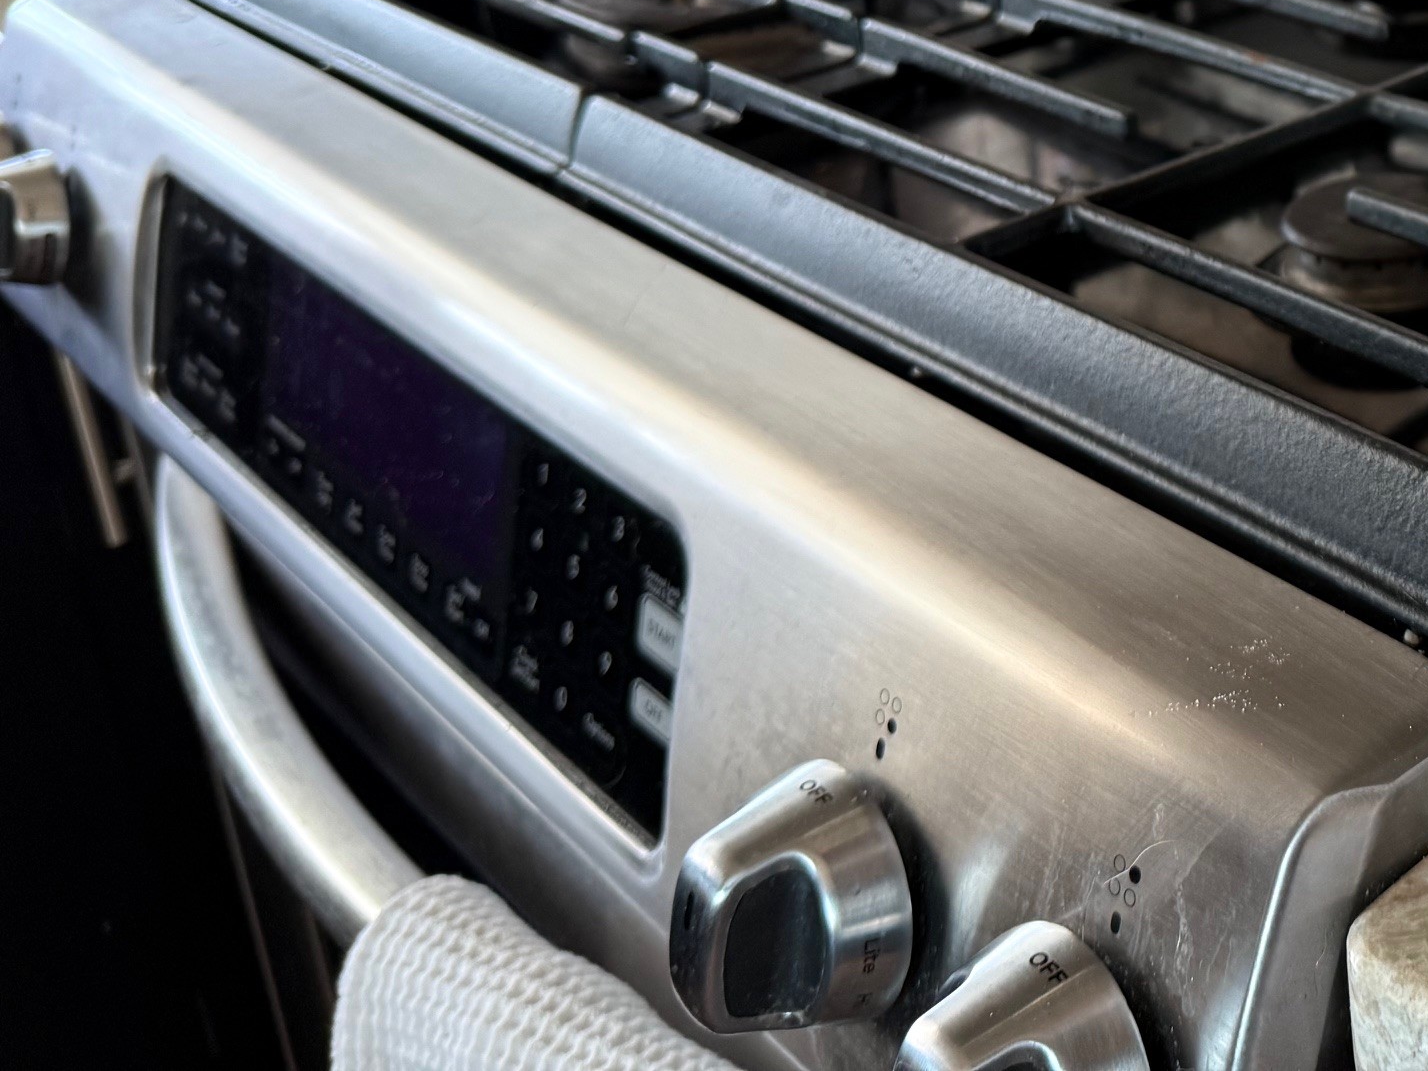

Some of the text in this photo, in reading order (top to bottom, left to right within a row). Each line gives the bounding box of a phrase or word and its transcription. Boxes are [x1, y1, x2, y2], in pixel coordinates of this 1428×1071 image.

[799, 779, 834, 805] OFF
[863, 938, 881, 974] Lite
[1029, 951, 1069, 984] OFF
